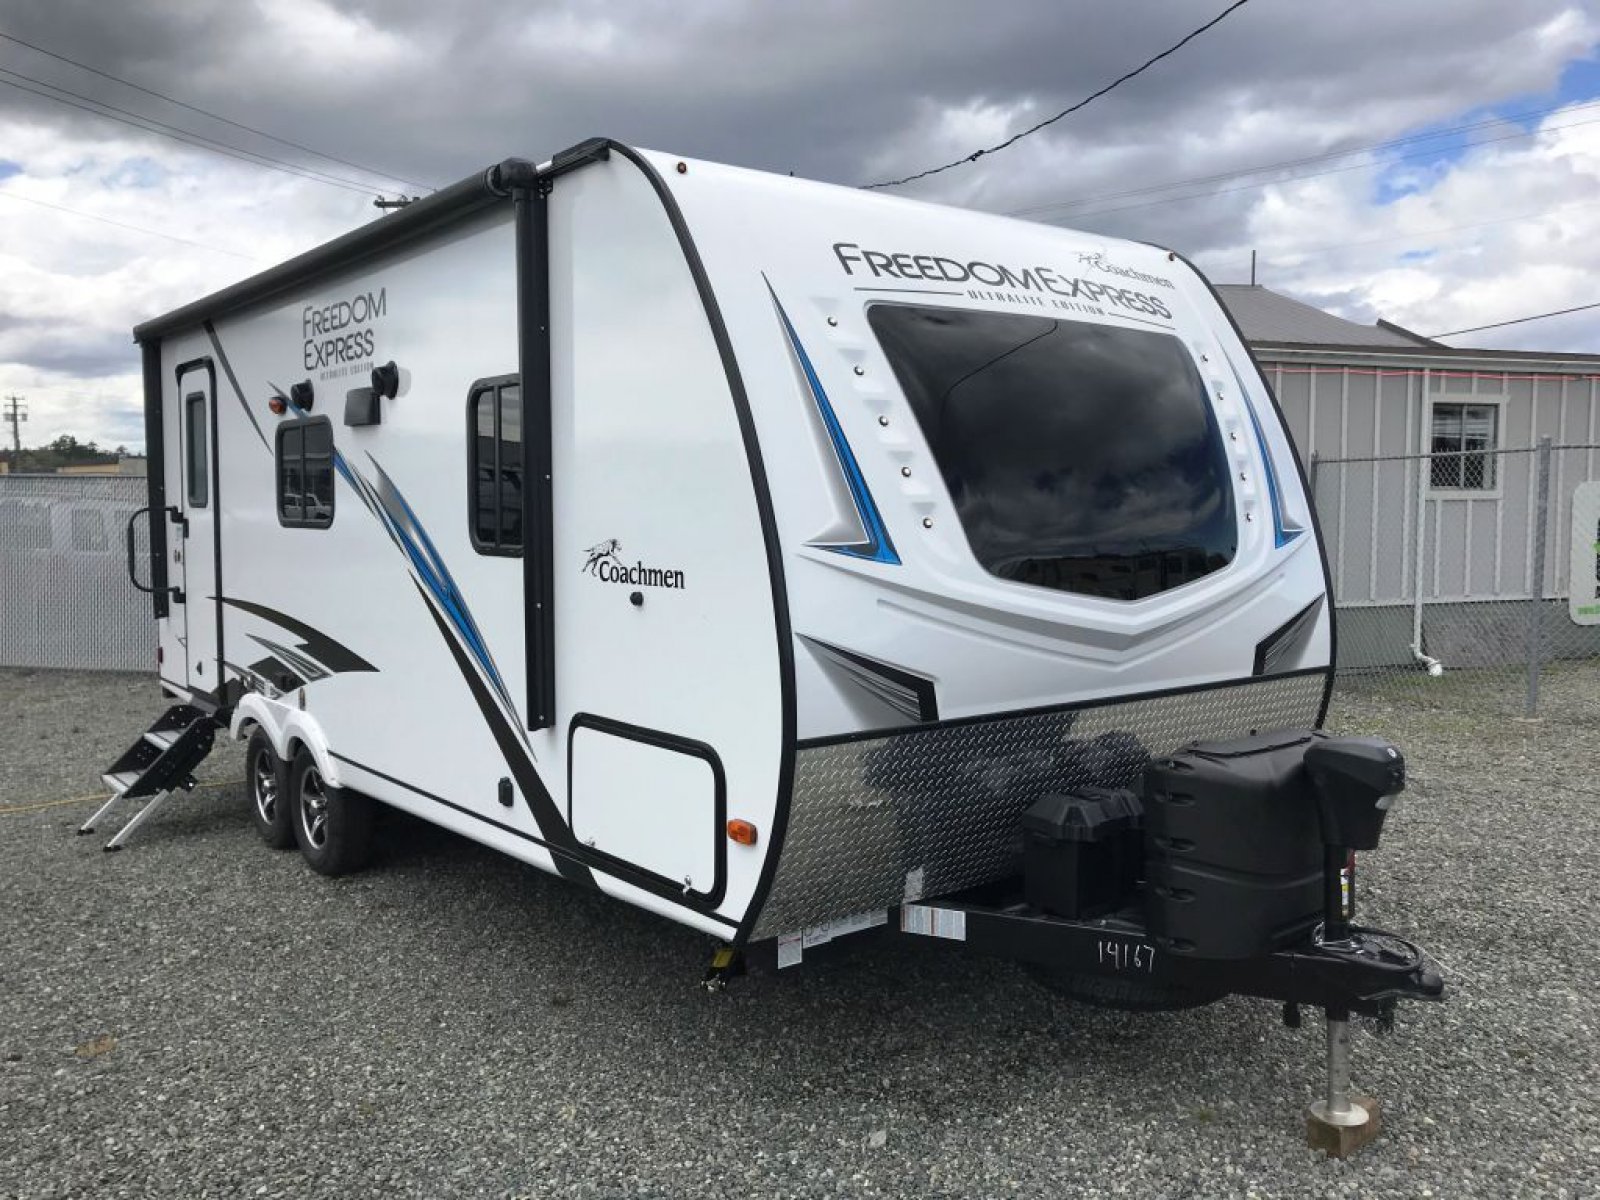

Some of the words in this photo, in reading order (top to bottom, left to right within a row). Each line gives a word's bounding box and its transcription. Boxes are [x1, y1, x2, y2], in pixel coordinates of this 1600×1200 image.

[303, 287, 386, 339] FREEDOM
[304, 328, 374, 370] EXPRESS
[599, 560, 686, 590] Coachmen
[1099, 941, 1155, 973] 14167
